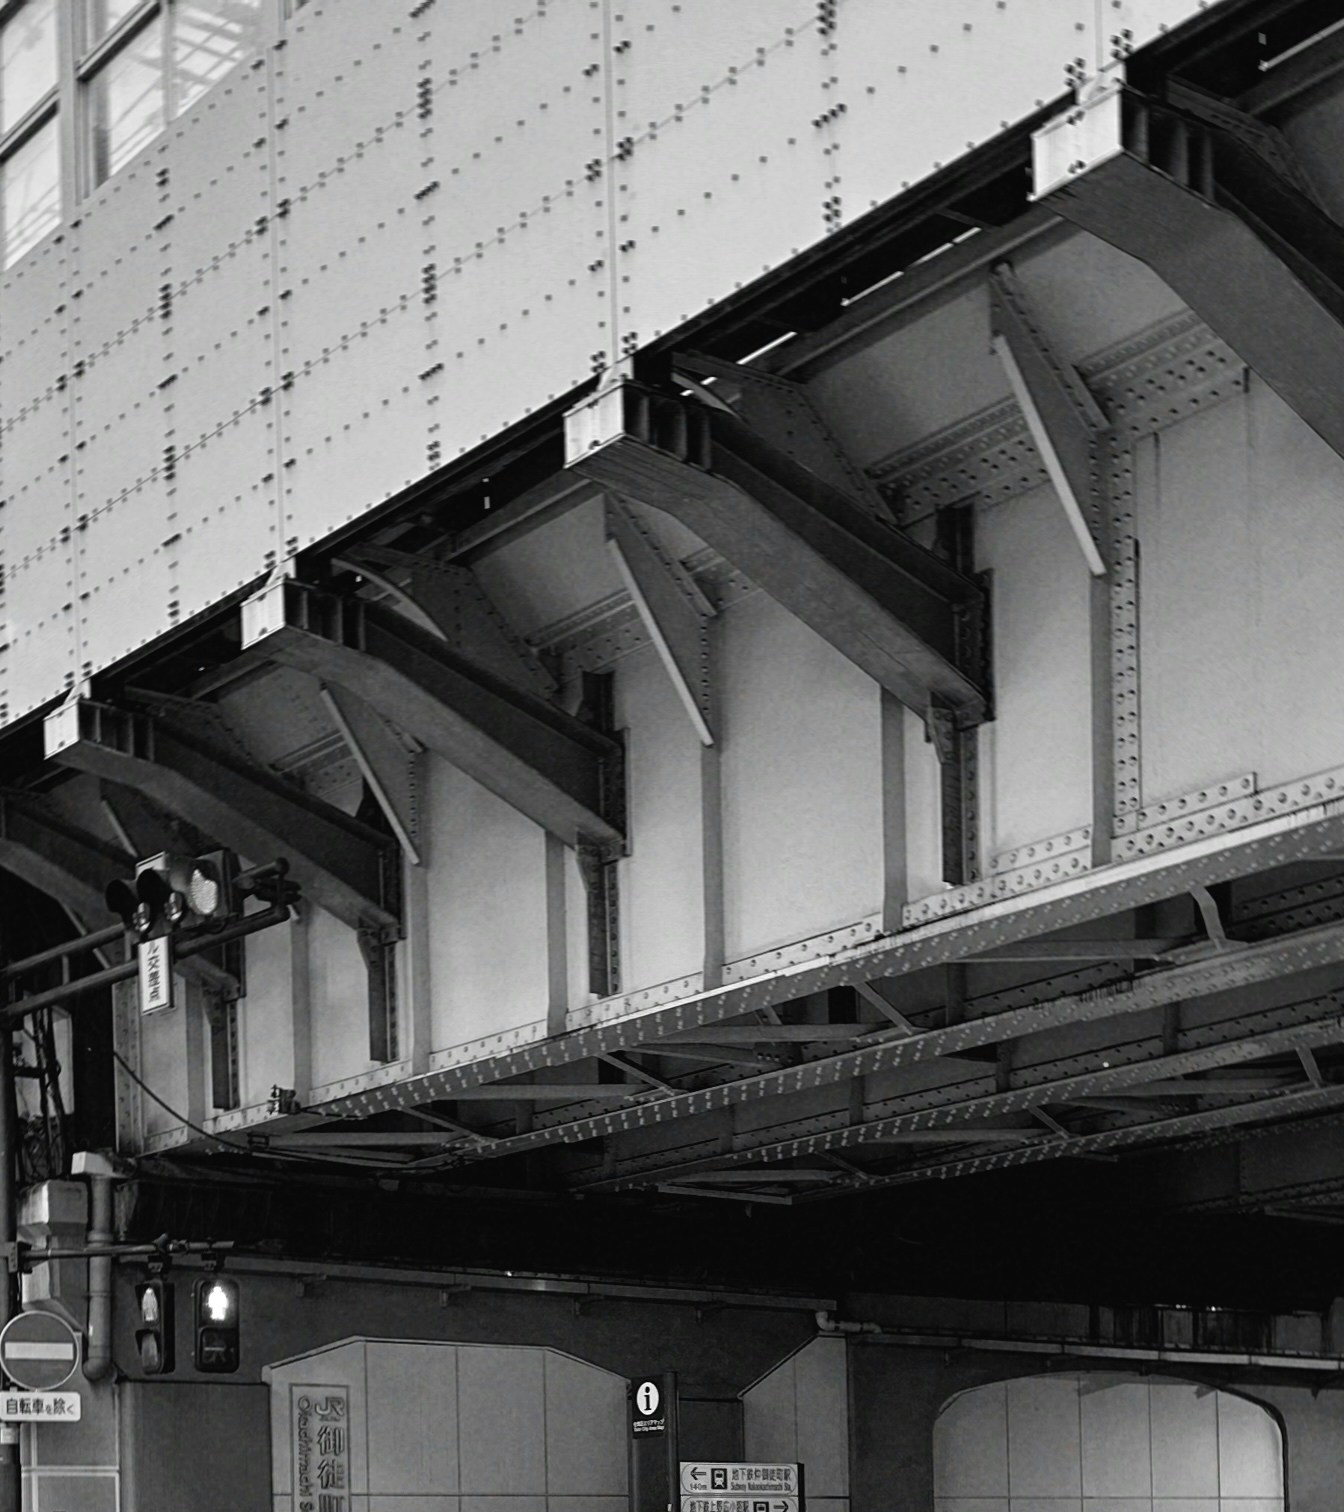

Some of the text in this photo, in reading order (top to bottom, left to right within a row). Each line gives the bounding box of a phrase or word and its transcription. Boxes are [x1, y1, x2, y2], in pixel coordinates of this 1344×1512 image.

[147, 941, 160, 1003] ル交差点
[7, 1398, 74, 1415] 自転車を除く
[315, 1396, 345, 1416] JR
[297, 1395, 312, 1497] Okachimachi
